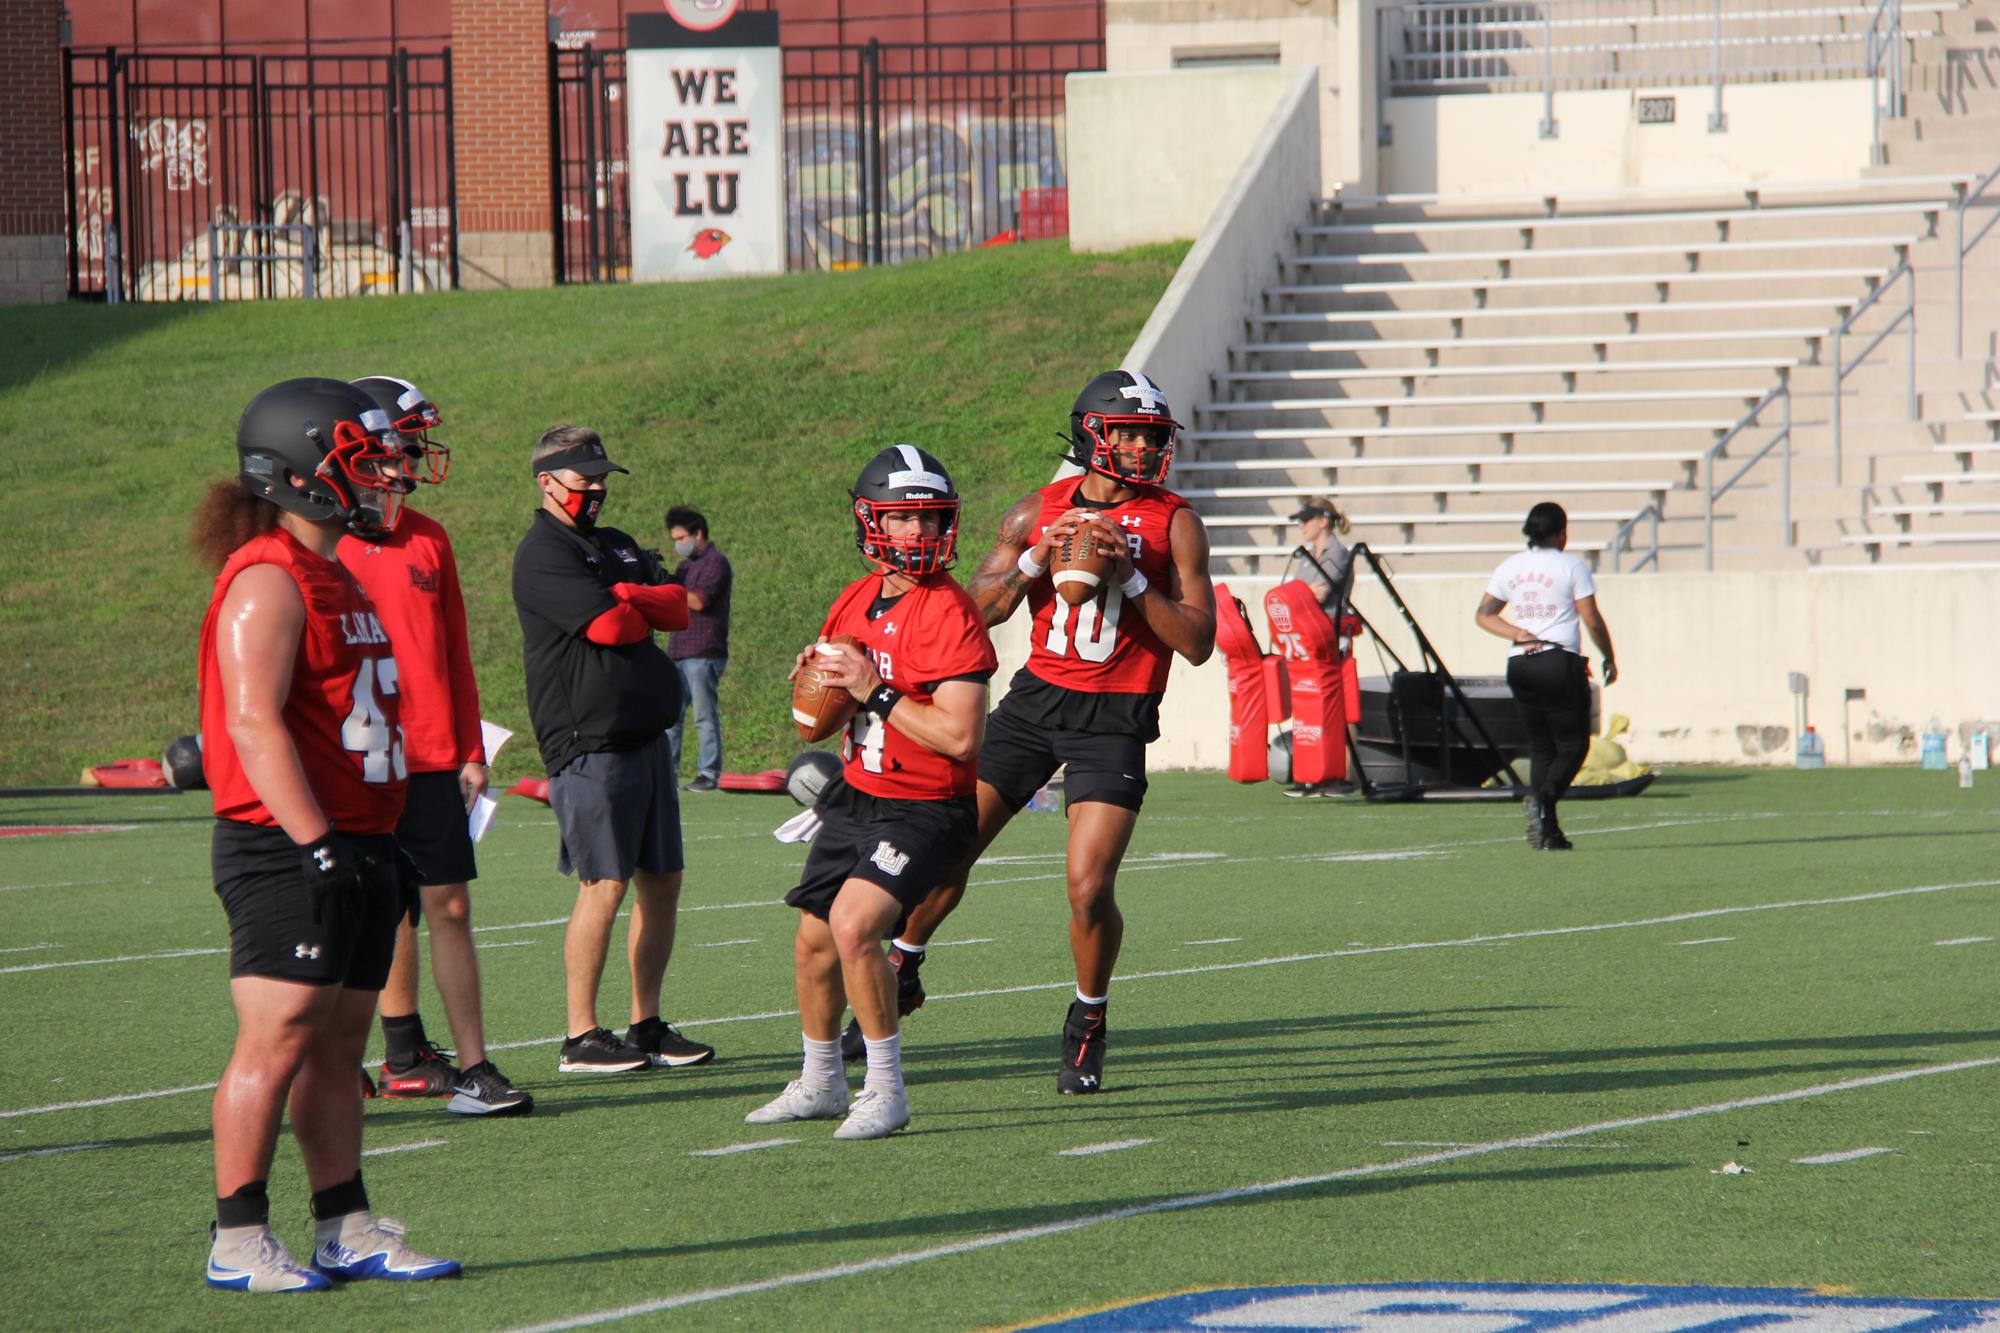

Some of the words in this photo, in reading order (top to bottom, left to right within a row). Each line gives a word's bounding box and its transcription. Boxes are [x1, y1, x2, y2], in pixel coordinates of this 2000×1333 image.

[671, 68, 737, 106] WE
[661, 119, 749, 157] ARE
[673, 170, 741, 217] LU
[905, 492, 934, 500] Riddell
[320, 1240, 360, 1268] NIKE
